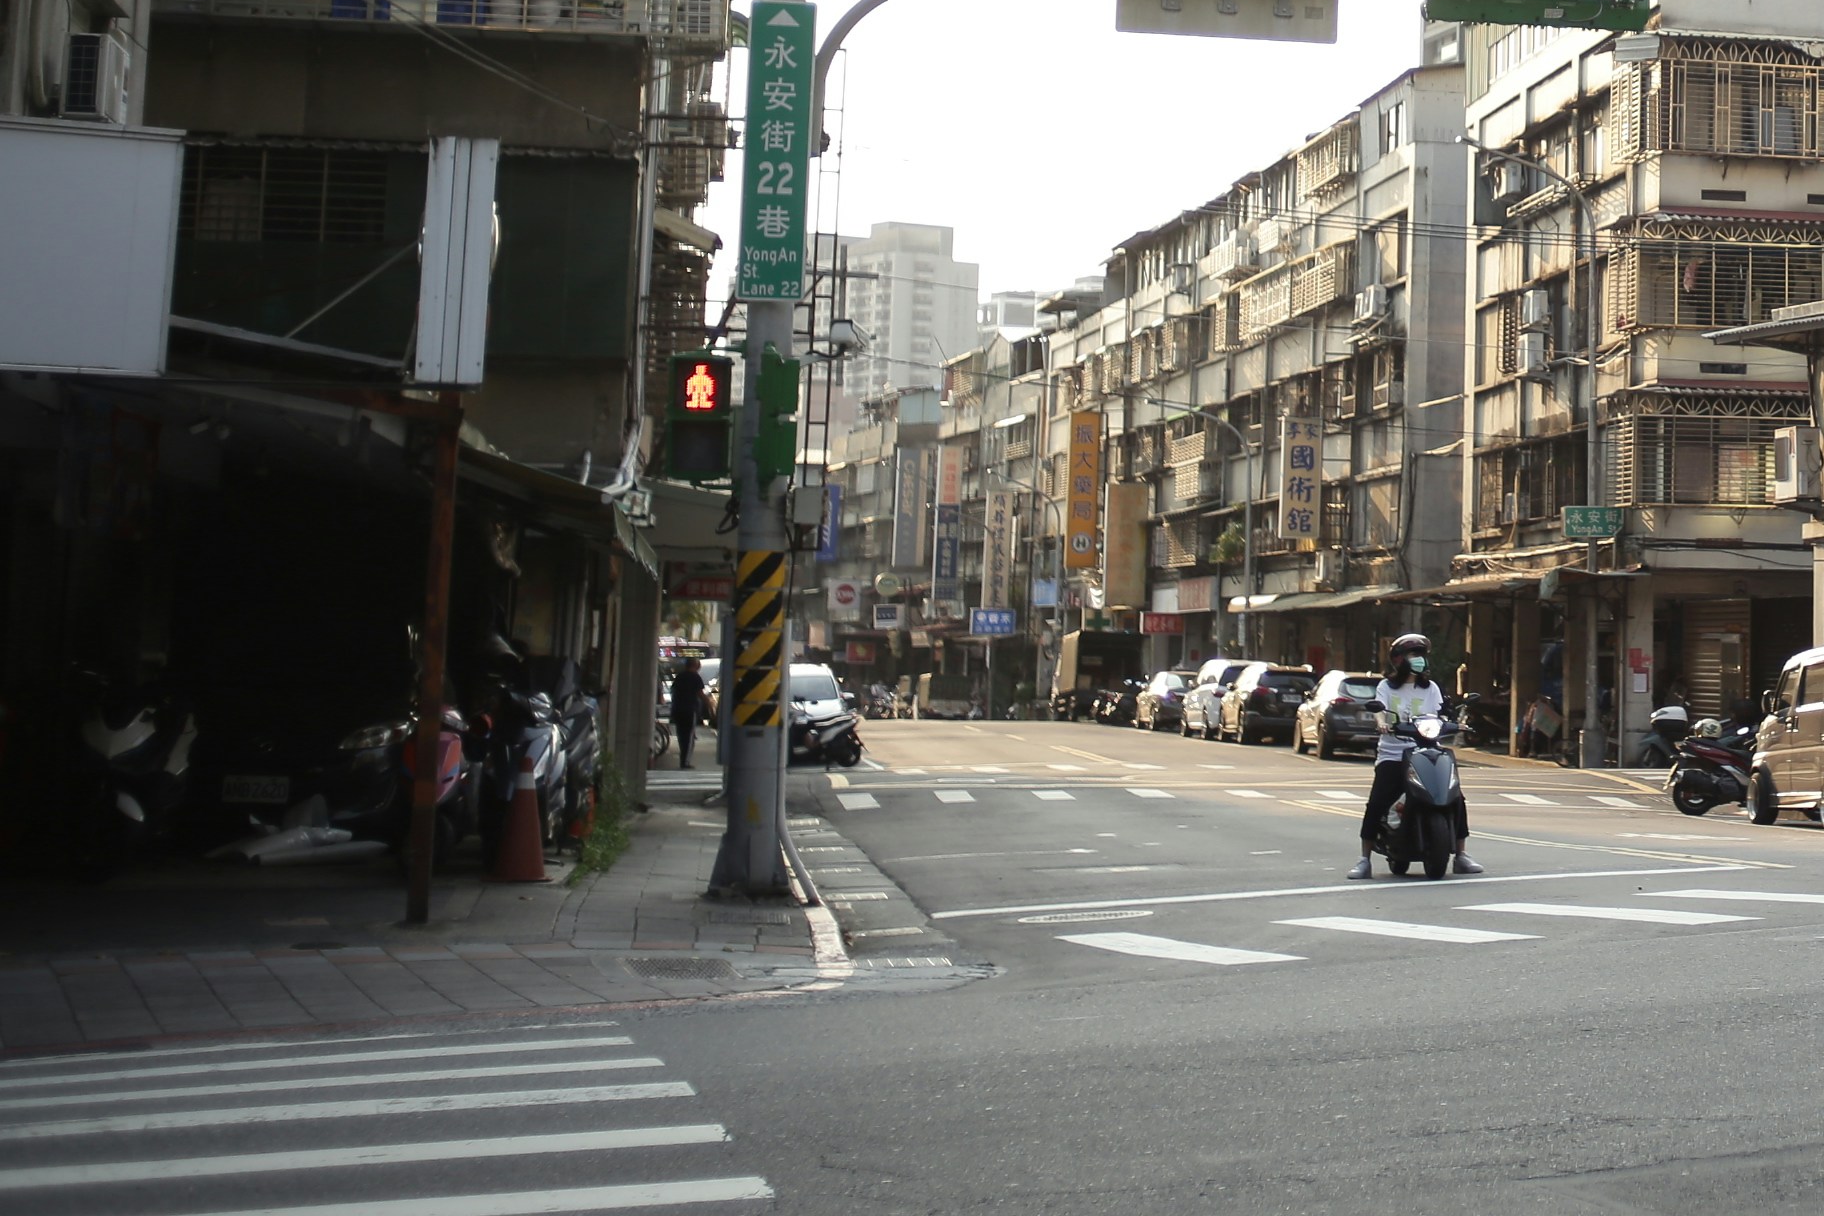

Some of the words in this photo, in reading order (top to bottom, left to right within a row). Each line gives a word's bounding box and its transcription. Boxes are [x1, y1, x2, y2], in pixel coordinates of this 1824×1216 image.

[744, 245, 797, 265] YongAn
[743, 264, 760, 278] St.
[741, 280, 775, 296] Lane
[781, 280, 799, 296] 22
[1287, 445, 1316, 533] 國術館
[1570, 509, 1618, 523] 永安街
